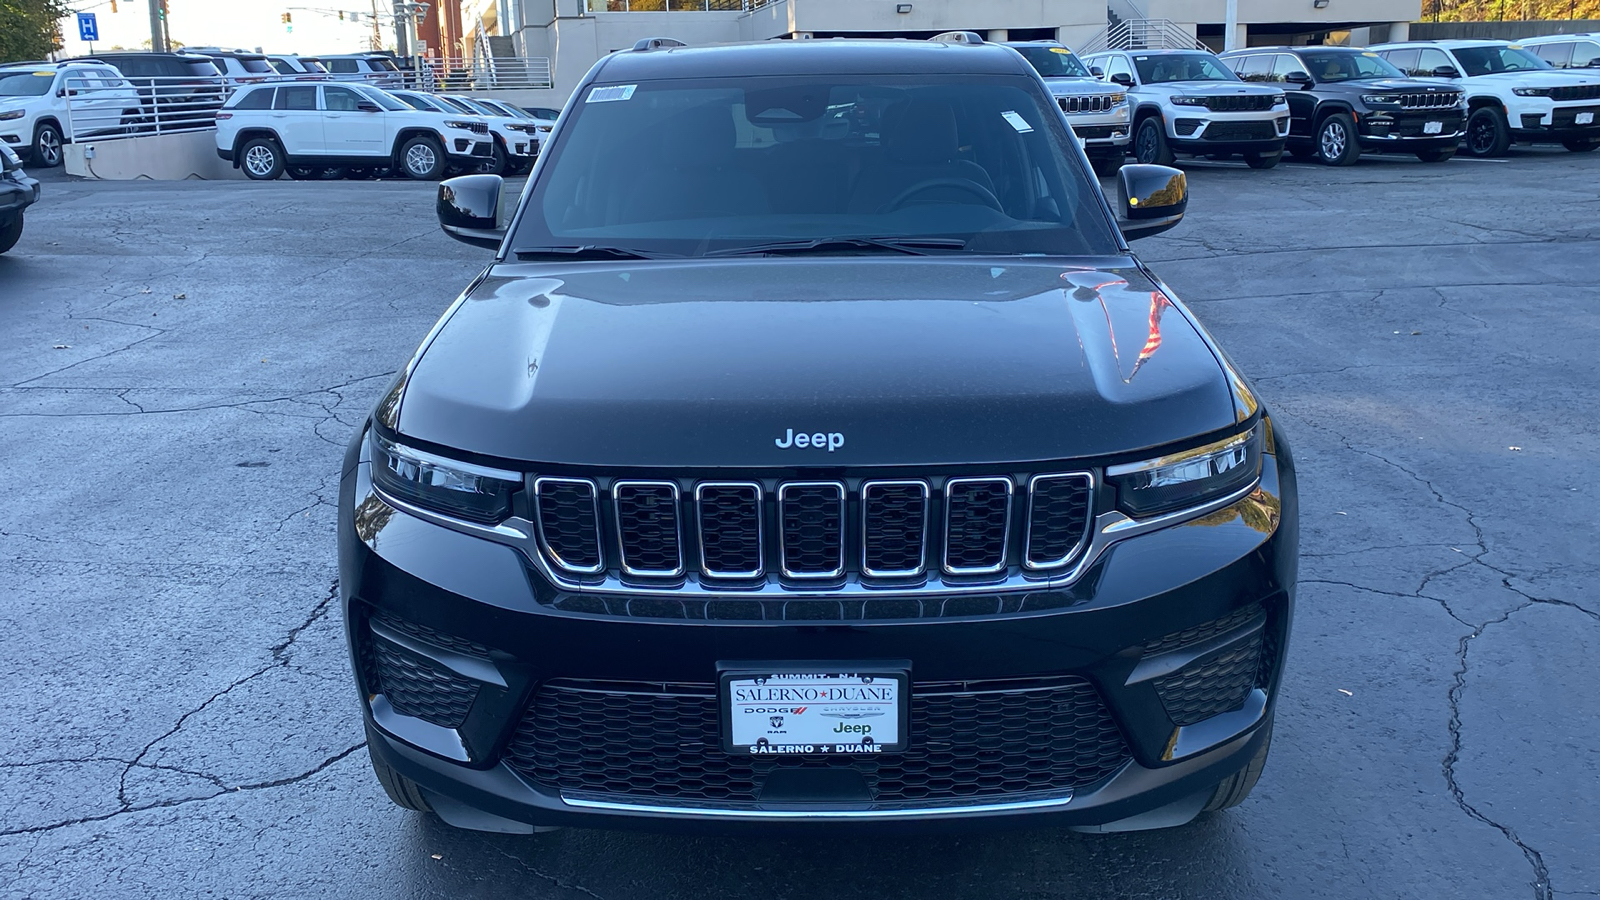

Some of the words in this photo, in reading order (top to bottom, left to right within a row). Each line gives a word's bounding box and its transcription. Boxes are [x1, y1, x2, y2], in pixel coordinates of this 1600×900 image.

[81, 19, 94, 33] H
[775, 428, 845, 452] Jeep
[736, 689, 818, 701] SALERNO
[829, 688, 893, 700] DUANE
[833, 722, 872, 735] Jeep
[749, 745, 814, 754] SALERNO
[835, 744, 882, 753] DUANE
